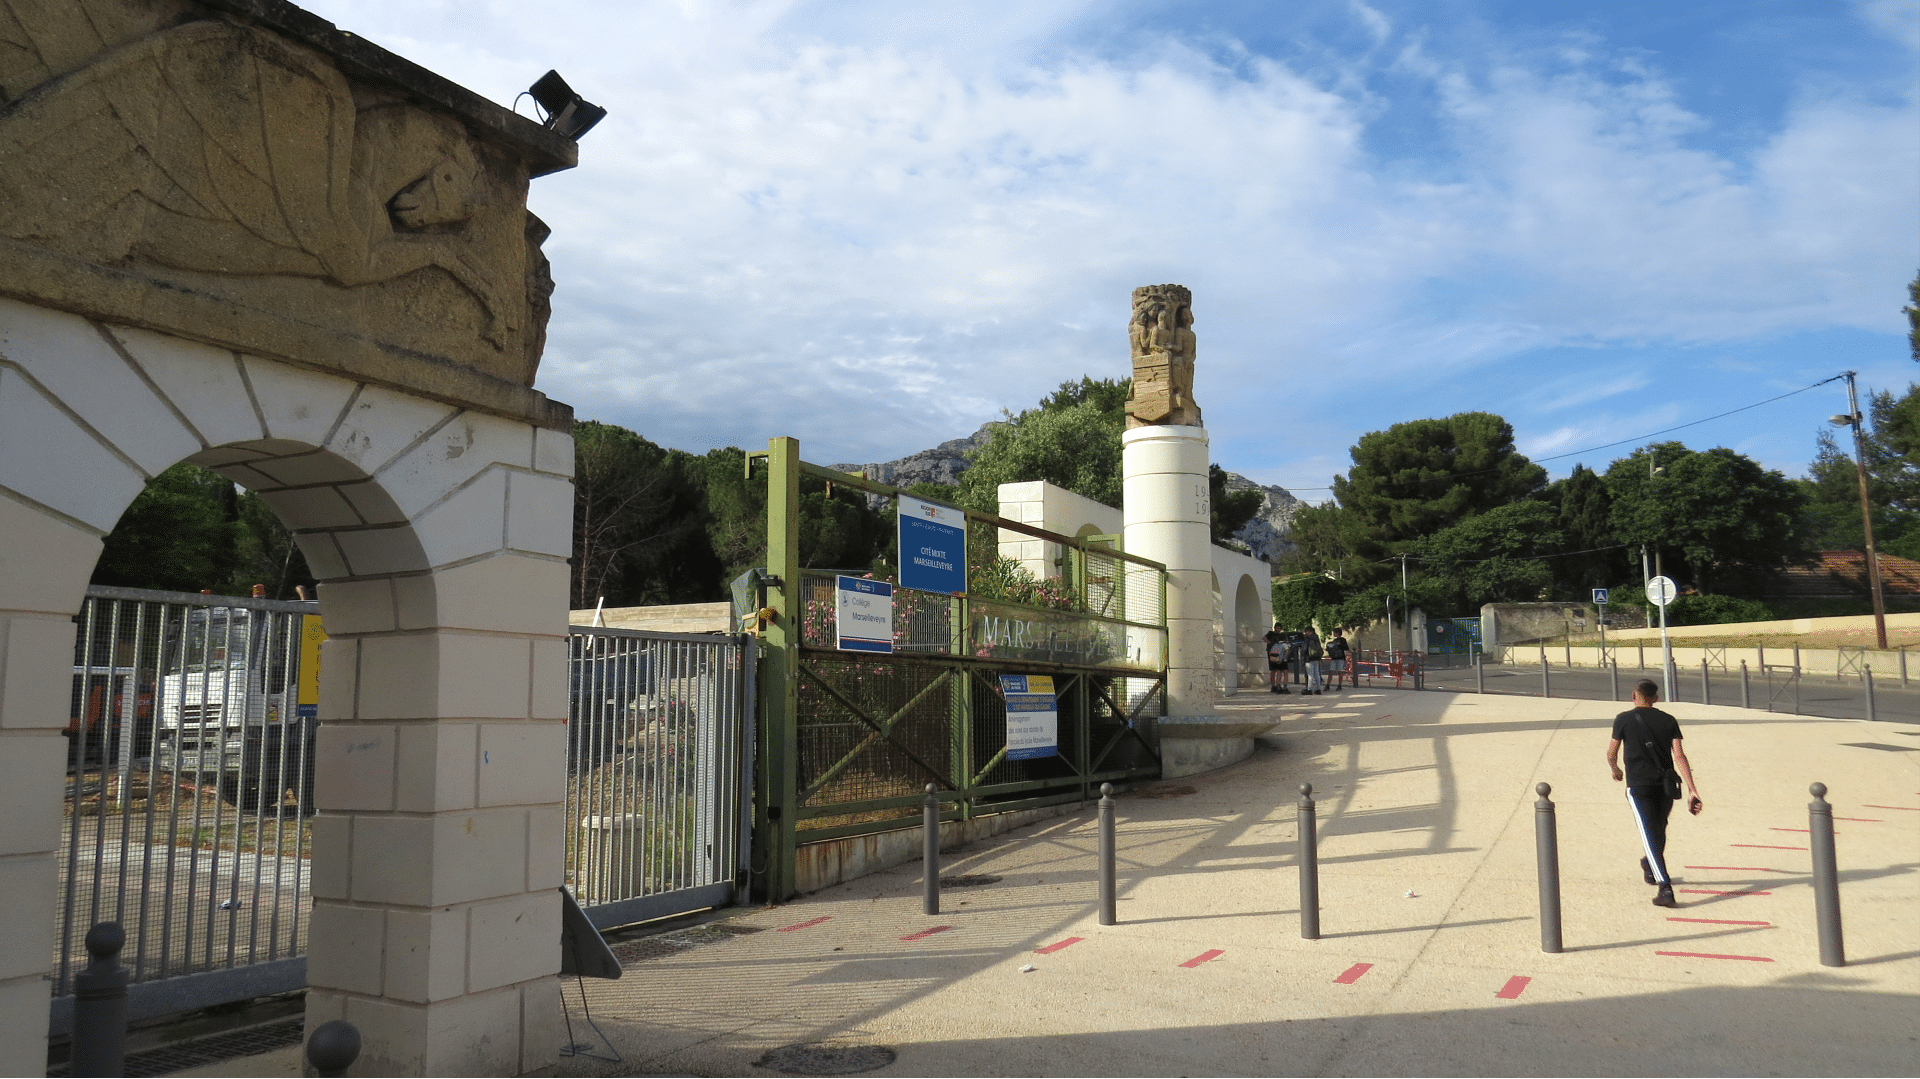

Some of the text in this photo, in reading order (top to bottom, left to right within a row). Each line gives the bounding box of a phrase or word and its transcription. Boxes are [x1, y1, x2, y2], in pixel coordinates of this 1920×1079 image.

[920, 546, 947, 560] CITÉ MIXTE
[913, 556, 953, 572] MARSEILLEVEYRE
[851, 596, 871, 609] Collège
[852, 611, 886, 625] Marseilleveyre
